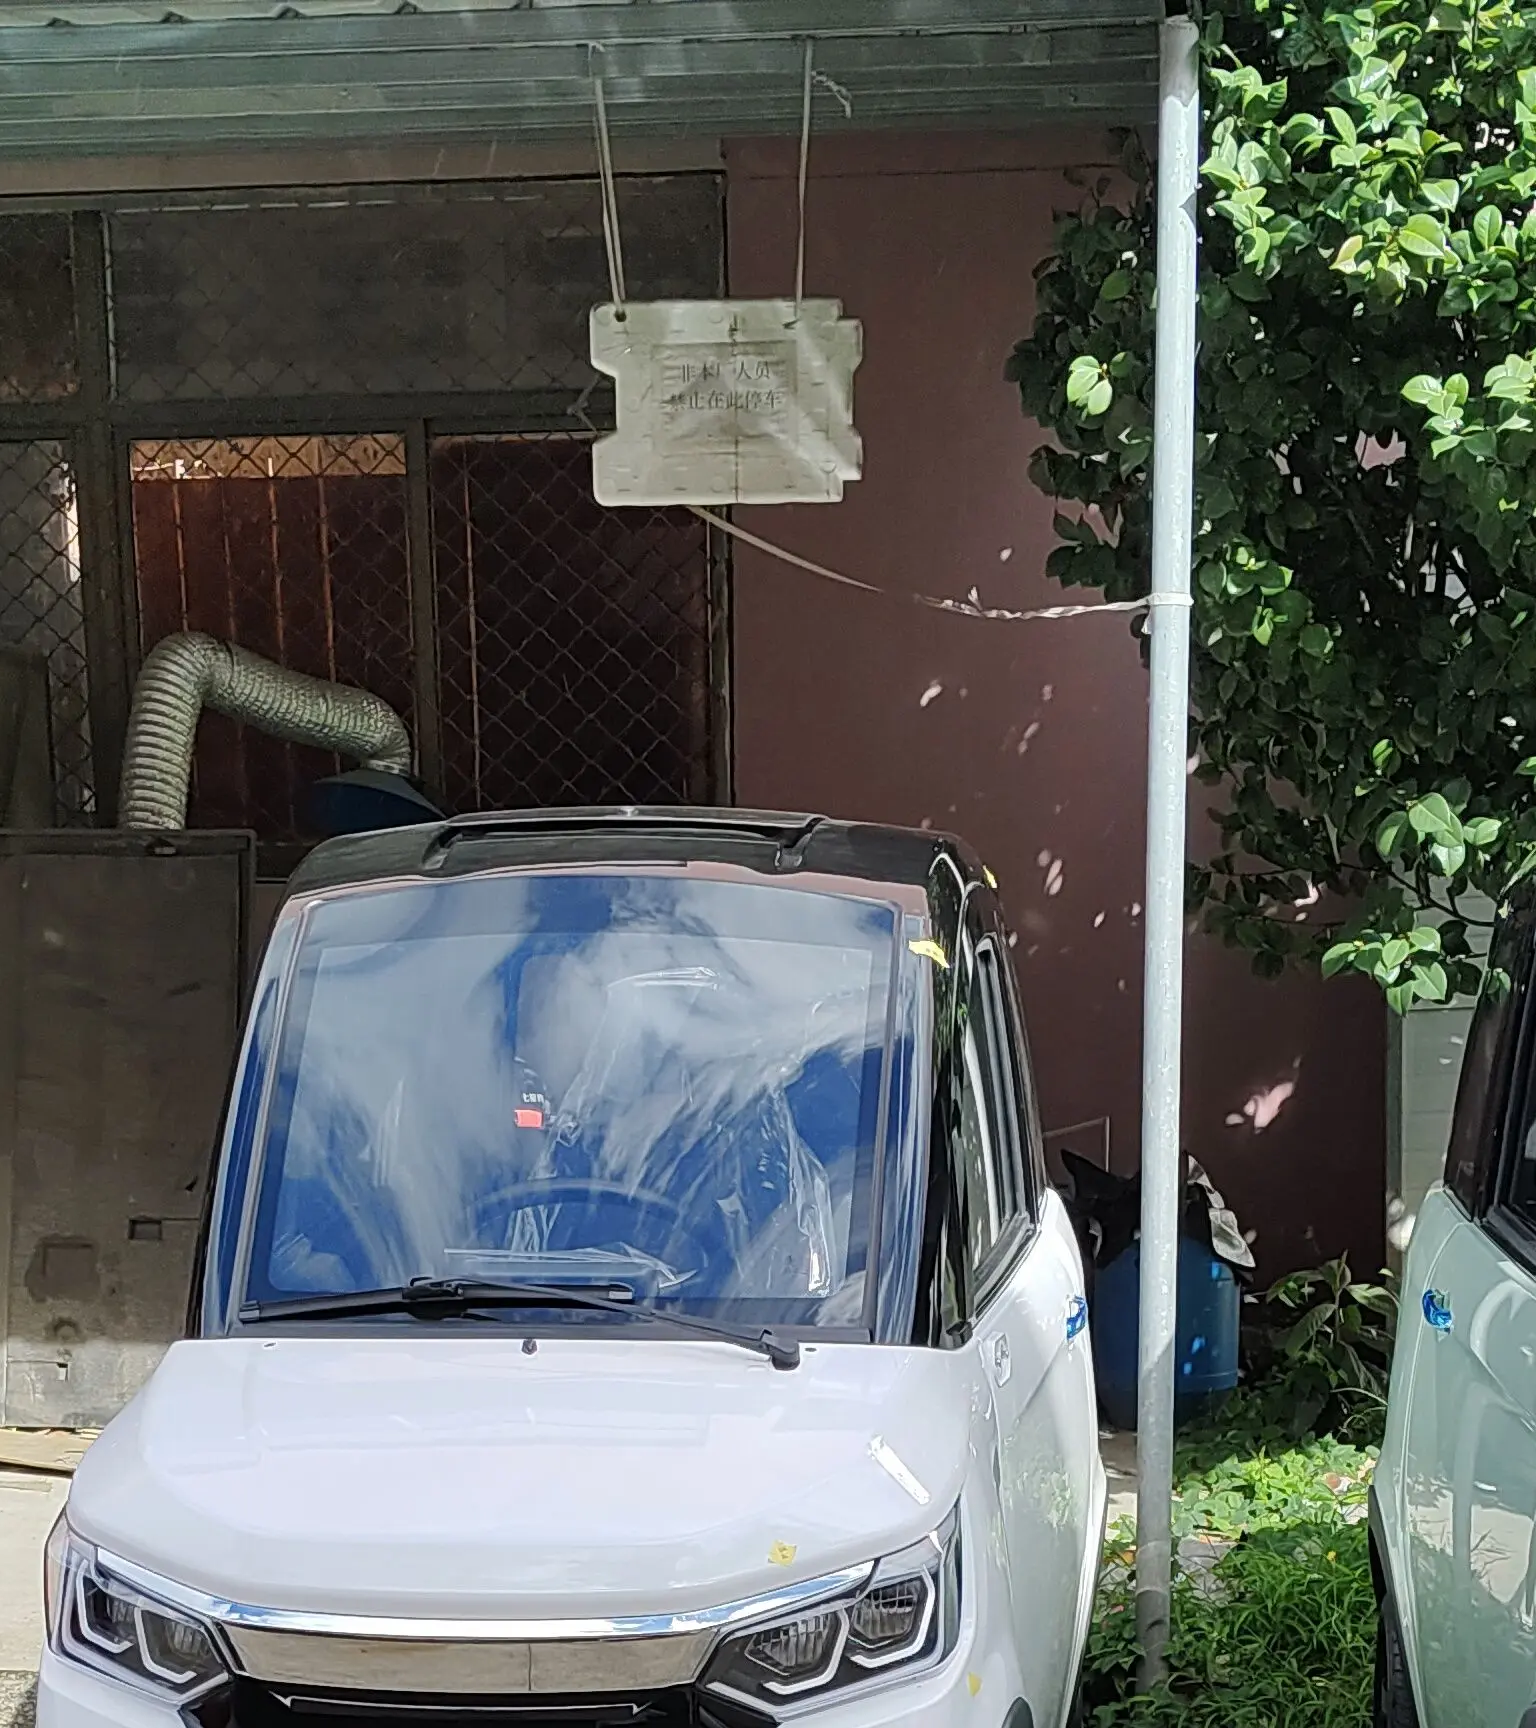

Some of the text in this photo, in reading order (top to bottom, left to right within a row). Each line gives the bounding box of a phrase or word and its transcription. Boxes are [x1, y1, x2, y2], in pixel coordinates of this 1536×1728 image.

[681, 360, 771, 383] 非本厂人员
[667, 389, 785, 410] 禁止在此停车
